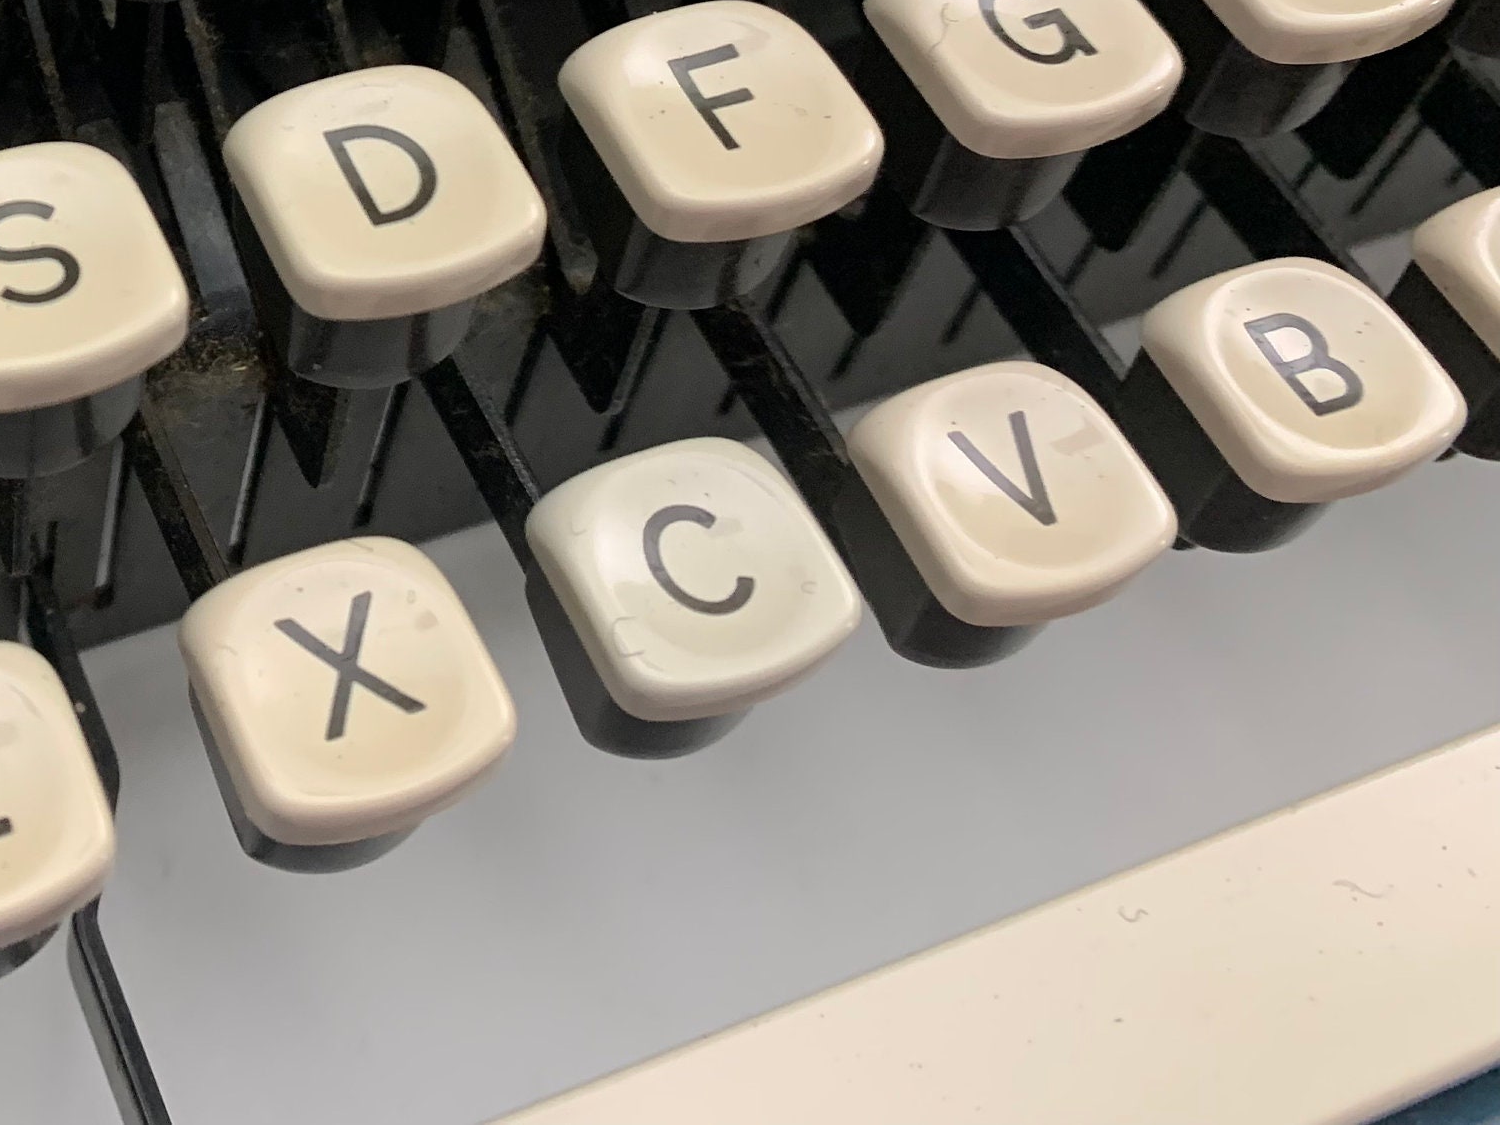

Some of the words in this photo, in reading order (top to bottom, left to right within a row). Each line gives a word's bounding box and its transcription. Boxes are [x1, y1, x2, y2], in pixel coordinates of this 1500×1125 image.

[668, 43, 754, 151] F
[323, 124, 438, 227] D
[1243, 312, 1364, 417] B
[947, 410, 1058, 527] V
[642, 504, 755, 616] C
[274, 591, 427, 742] X
